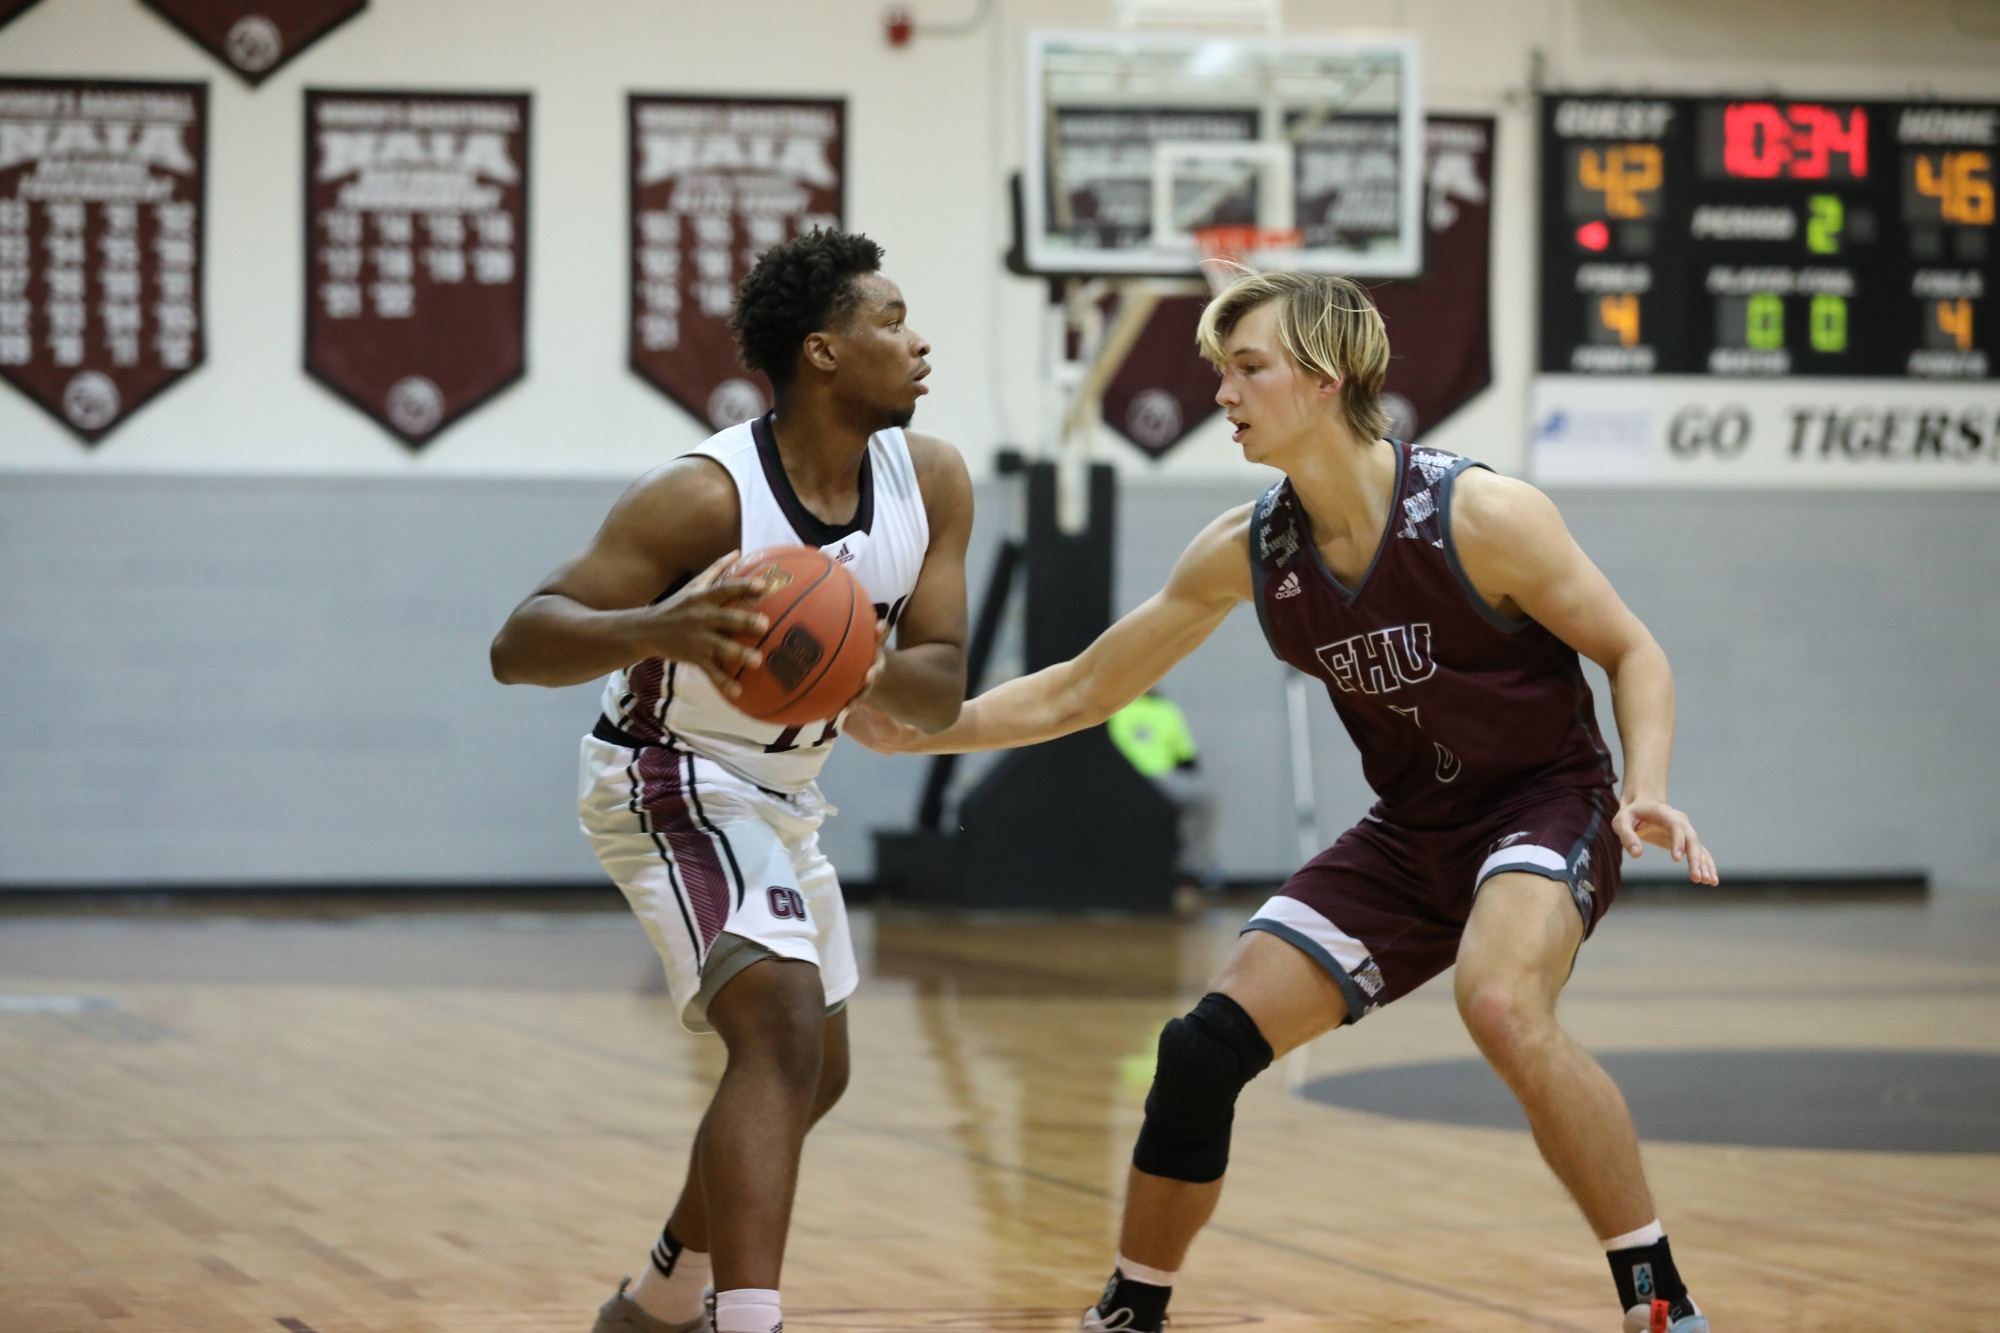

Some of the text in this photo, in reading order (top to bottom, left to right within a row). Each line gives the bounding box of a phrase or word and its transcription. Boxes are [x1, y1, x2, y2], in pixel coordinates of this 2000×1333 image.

[1555, 102, 1669, 138] GUEST
[1723, 103, 1867, 178] 10:34
[1898, 109, 1999, 143] HOME
[0, 121, 195, 178] NAIA
[318, 130, 519, 184] NAIA
[637, 132, 837, 188] NAIA
[1579, 145, 1663, 218] 42
[1915, 152, 1995, 225] 46
[1691, 195, 1844, 254] PERIOD 2
[1601, 294, 1640, 346] 4
[1747, 295, 1784, 350] 0
[1810, 296, 1847, 351] 0
[1937, 299, 1973, 351] 4
[1667, 405, 1750, 461] GO
[1275, 586, 1301, 600] adidas
[766, 886, 806, 921] CU
